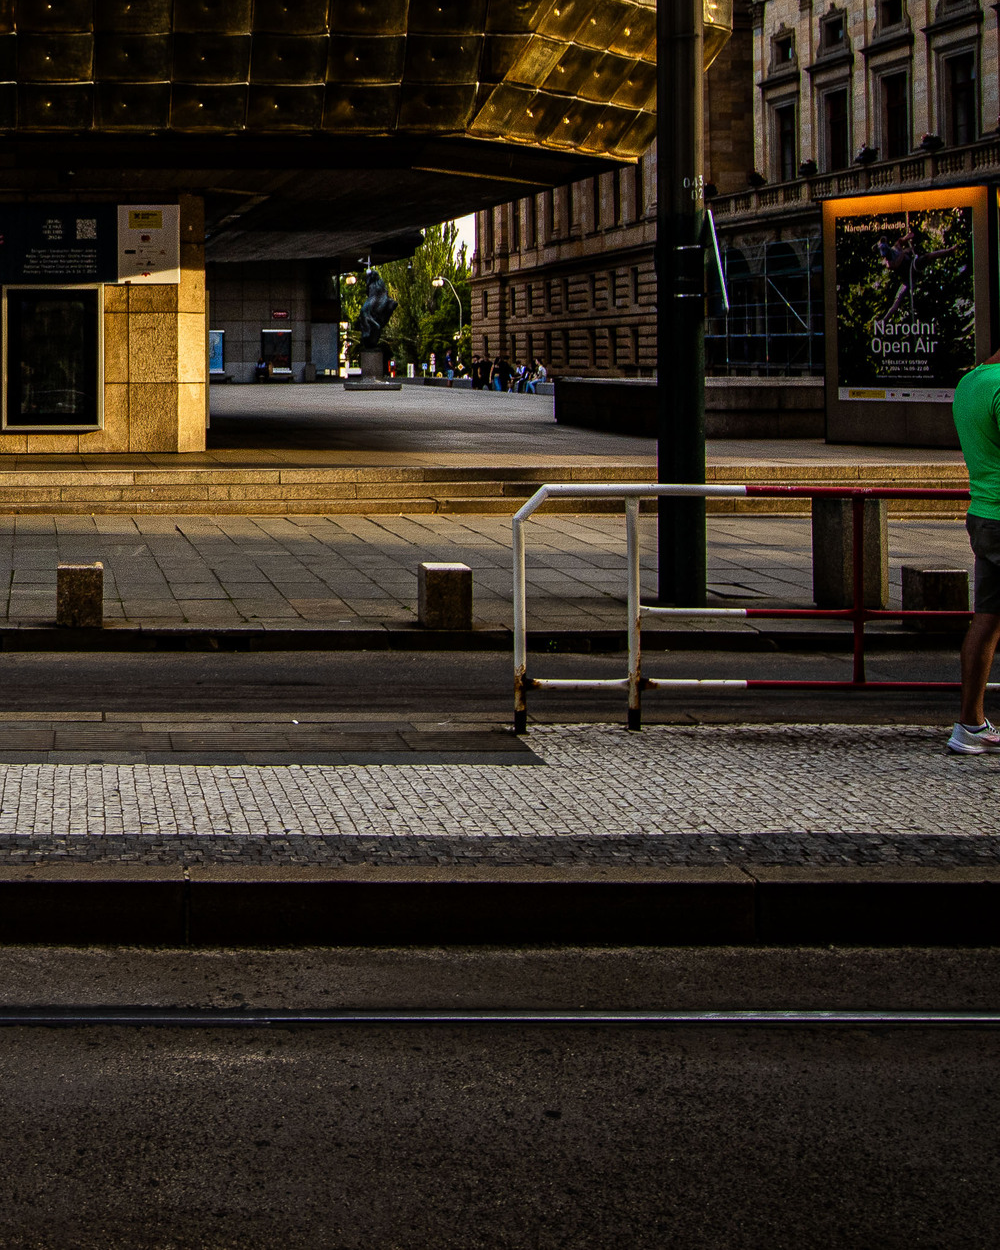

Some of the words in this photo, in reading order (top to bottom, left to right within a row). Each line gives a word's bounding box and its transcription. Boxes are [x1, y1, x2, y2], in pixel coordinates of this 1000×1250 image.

[873, 317, 936, 336] Národní
[871, 337, 911, 357] Open
[914, 337, 939, 353] Air
